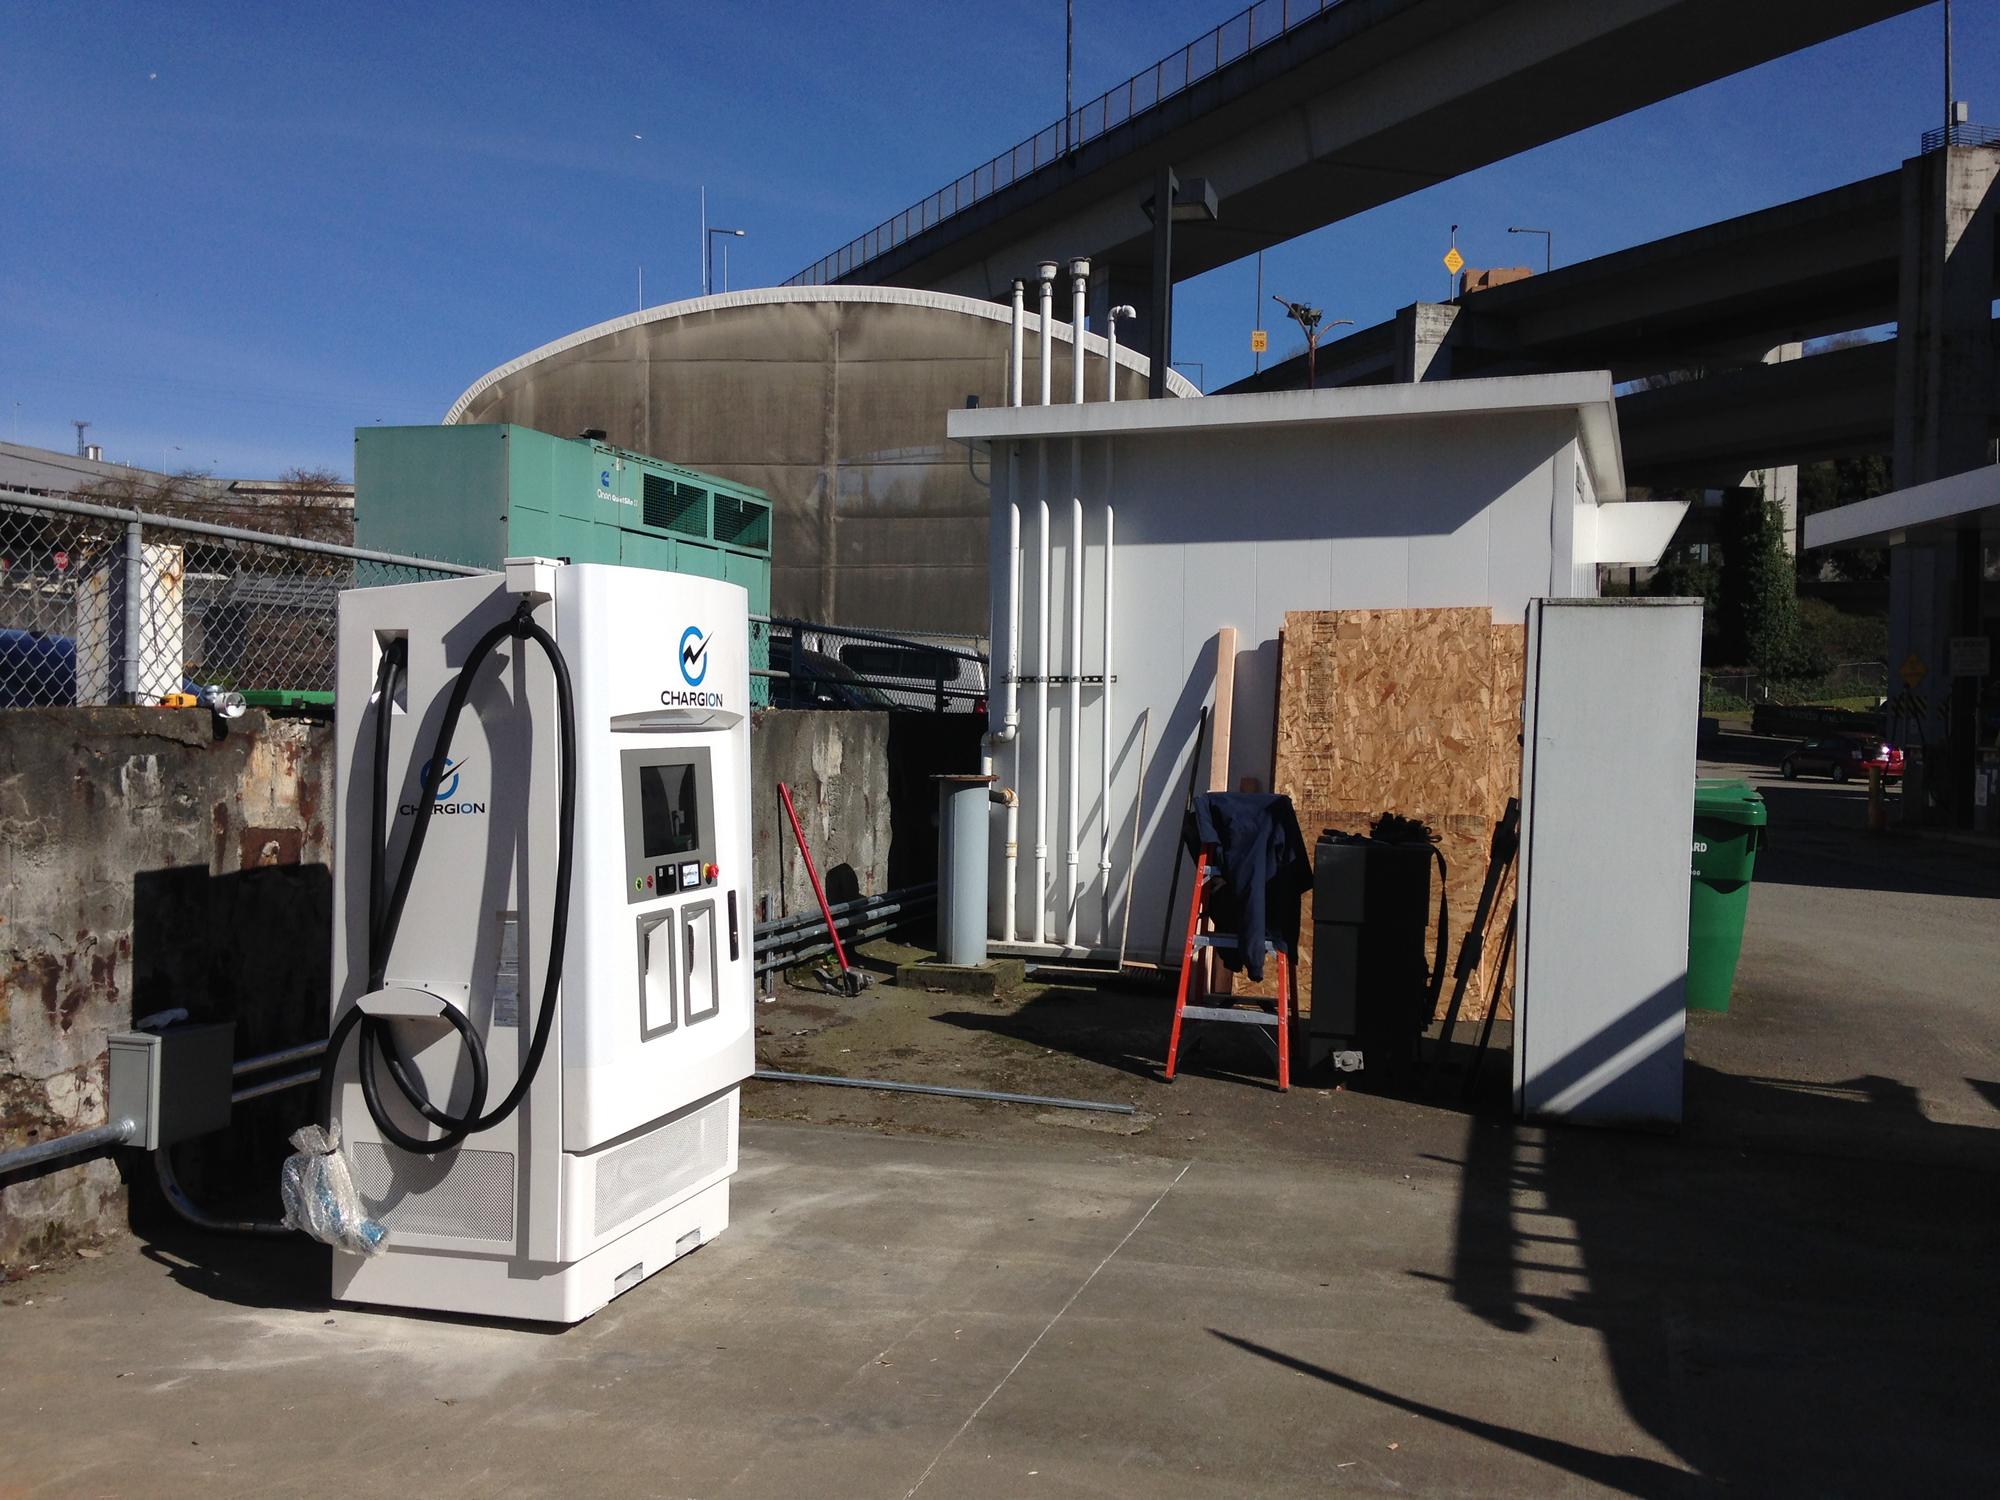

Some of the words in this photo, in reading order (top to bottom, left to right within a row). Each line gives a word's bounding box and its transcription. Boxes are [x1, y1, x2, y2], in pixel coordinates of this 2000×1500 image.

[660, 690, 723, 707] CHARGION
[400, 802, 485, 816] CHRGION
[1691, 842, 1708, 853] RD
